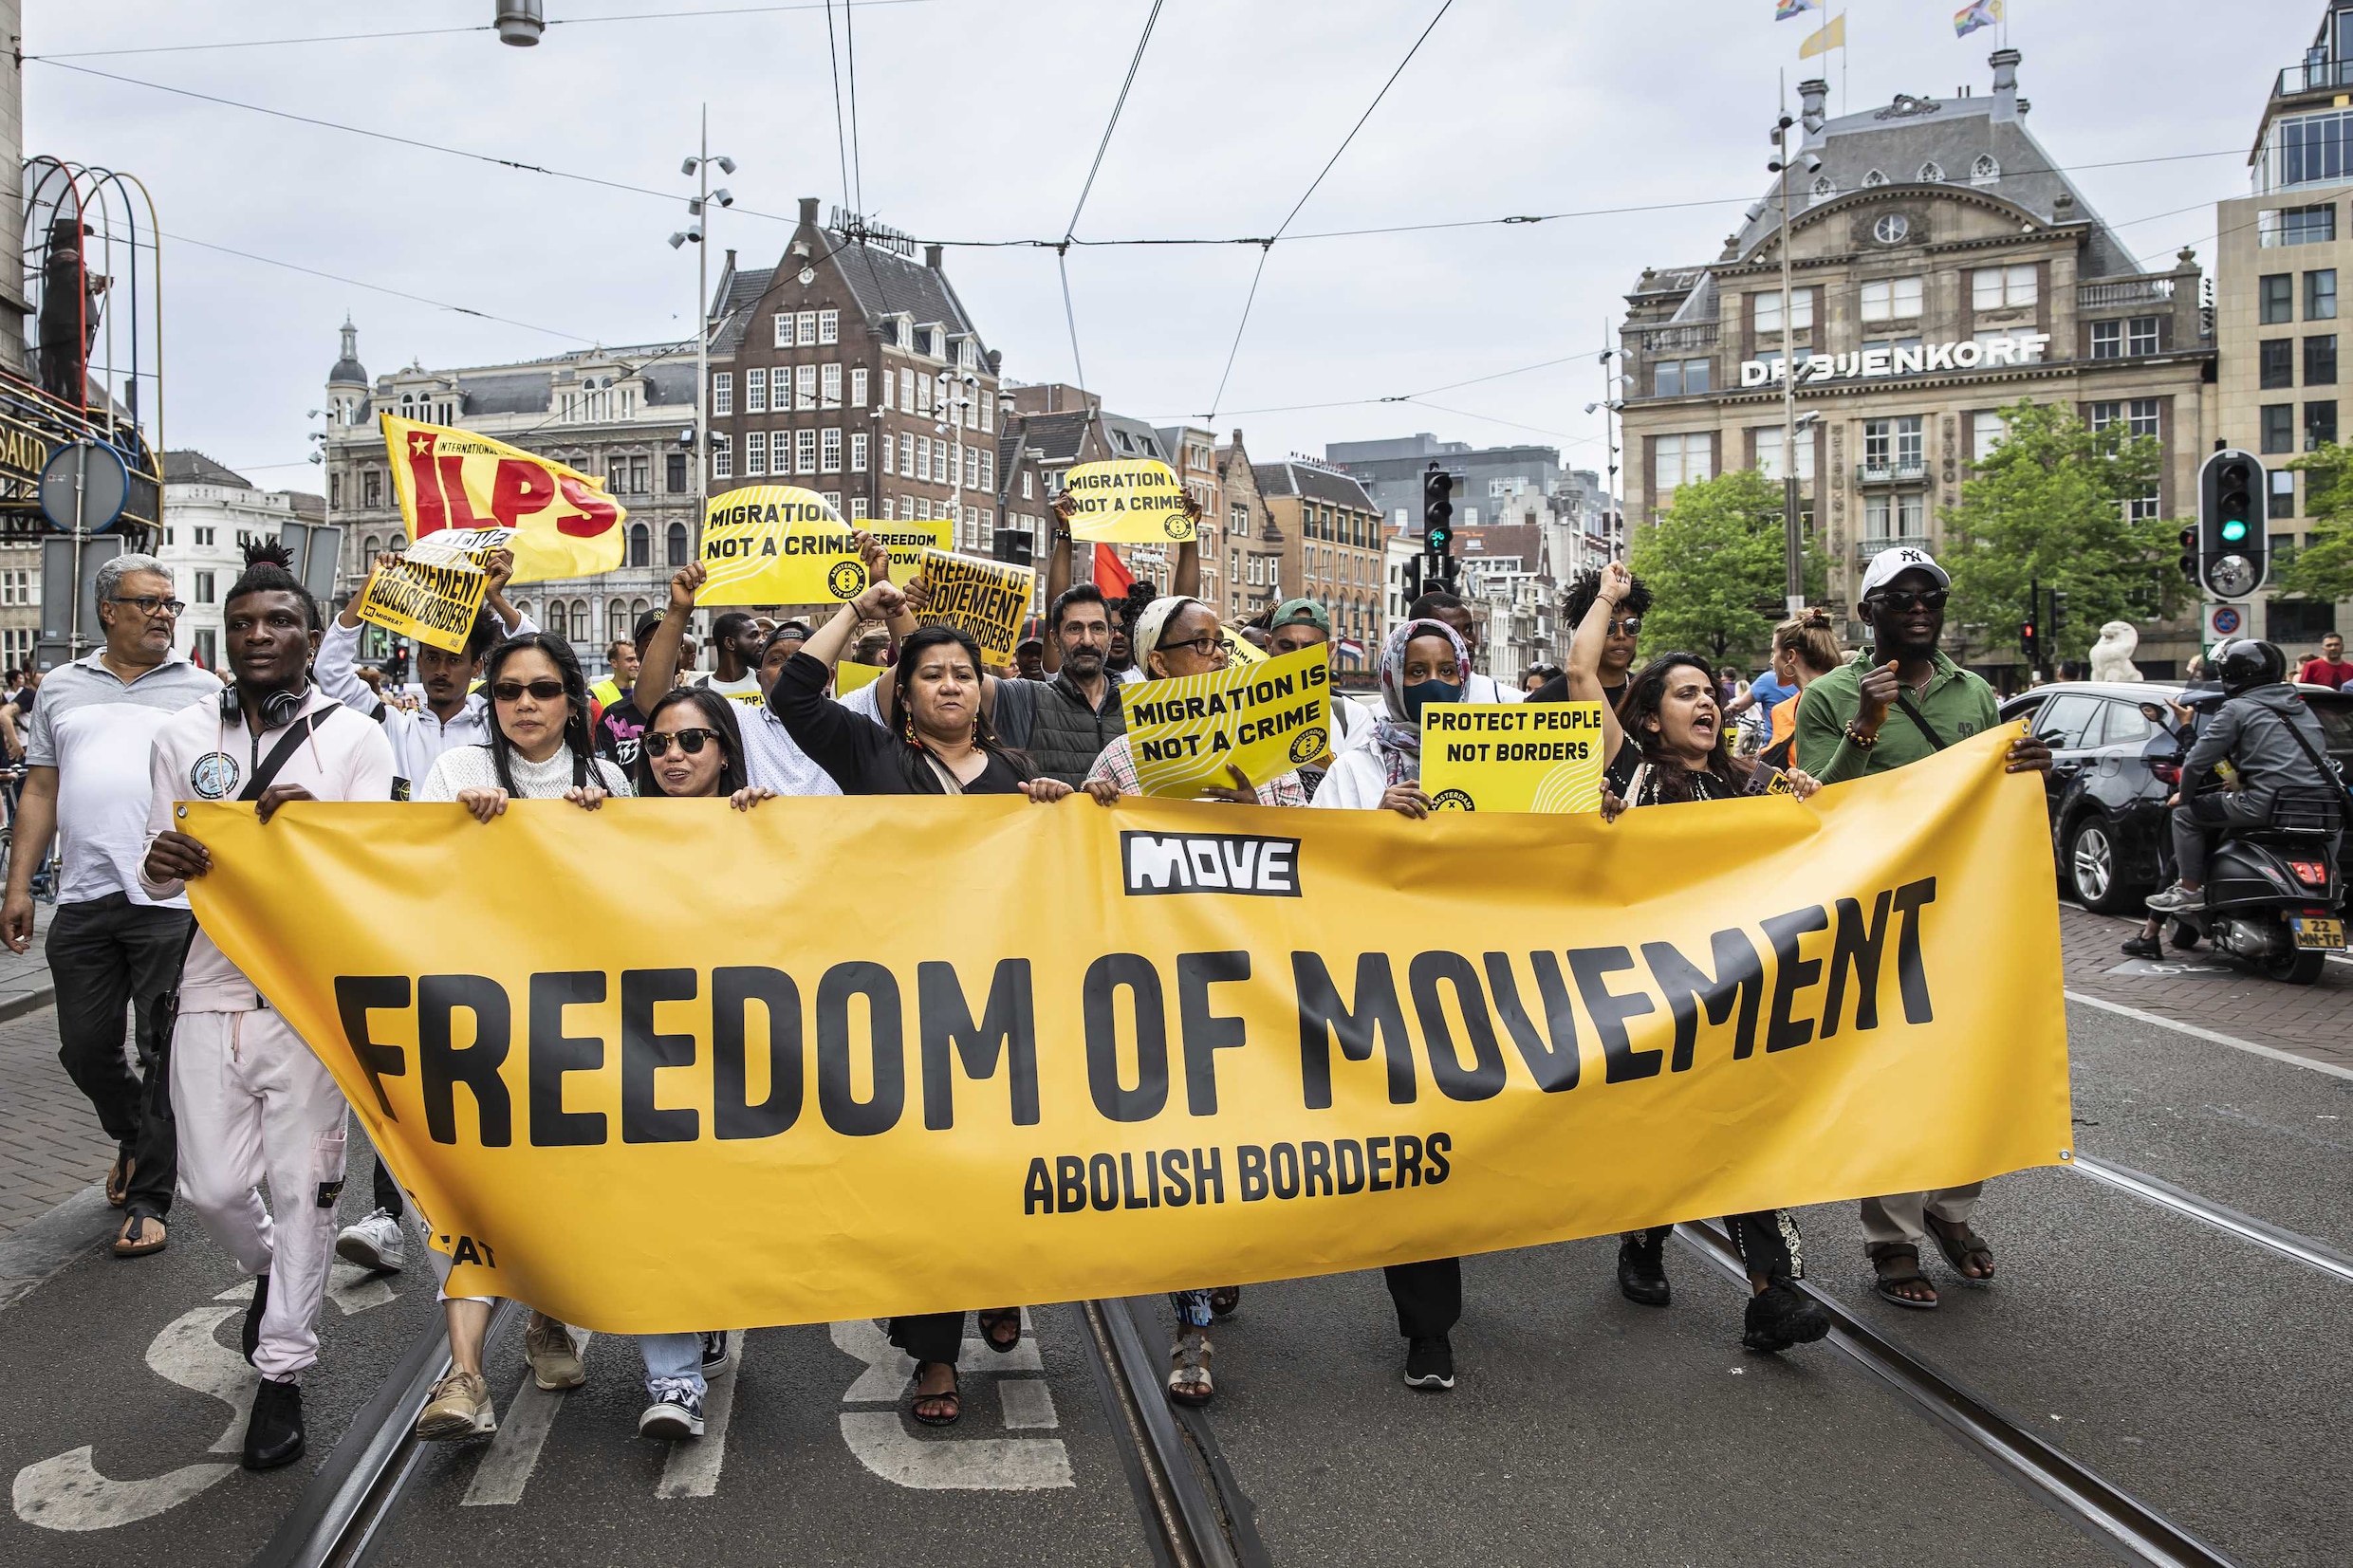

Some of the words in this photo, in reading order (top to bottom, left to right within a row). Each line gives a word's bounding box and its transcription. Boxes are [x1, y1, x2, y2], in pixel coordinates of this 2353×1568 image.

[1740, 357, 1799, 387] DE
[1805, 334, 2050, 381] BIJENKORF
[408, 432, 618, 540] ILPS
[1069, 472, 1165, 489] MIGRATION
[1075, 498, 1107, 513] NOT
[1114, 498, 1125, 511] A
[1130, 495, 1183, 511] CRIME
[710, 503, 838, 529] MIGRATION
[707, 538, 753, 560] NOT
[762, 537, 777, 556] A
[785, 534, 859, 555] CRIME
[872, 533, 936, 546] FREEDOM
[830, 563, 864, 578] AMSTERDAM
[925, 551, 1004, 587] FREEDOM
[1007, 569, 1030, 593] OF
[830, 584, 843, 597] CITY
[843, 582, 864, 598] RIGHTS
[368, 578, 424, 618] ABOLISH
[416, 595, 473, 635] BORDERS
[917, 577, 1026, 628] MOVEMENT
[376, 612, 403, 626] MIGREAT
[1133, 673, 1293, 727] MIGRATION
[1301, 664, 1326, 691] IS
[1142, 734, 1200, 761] NOT
[1213, 731, 1232, 753] A
[1238, 700, 1321, 746] CRIME
[1427, 712, 1528, 730] PROTECT
[1534, 710, 1602, 729] PEOPLE
[1291, 729, 1325, 750] AMSTERDAM
[1291, 754, 1303, 763] CITY
[1304, 742, 1325, 762] RIGHTS
[1448, 744, 1490, 762] NOT
[1496, 742, 1588, 762] BORDERS
[1432, 791, 1473, 810] AMSTERDAM
[1131, 837, 1293, 891] MOVE
[2310, 920, 2331, 932] 22
[2297, 932, 2342, 946] MN-TF
[334, 958, 1041, 1147] FREEDOM
[1083, 950, 1251, 1123] OF
[1290, 876, 1936, 1110] MOVEMENT
[1024, 1147, 1225, 1215] ABOLISH
[1236, 1132, 1452, 1202] BORDERS
